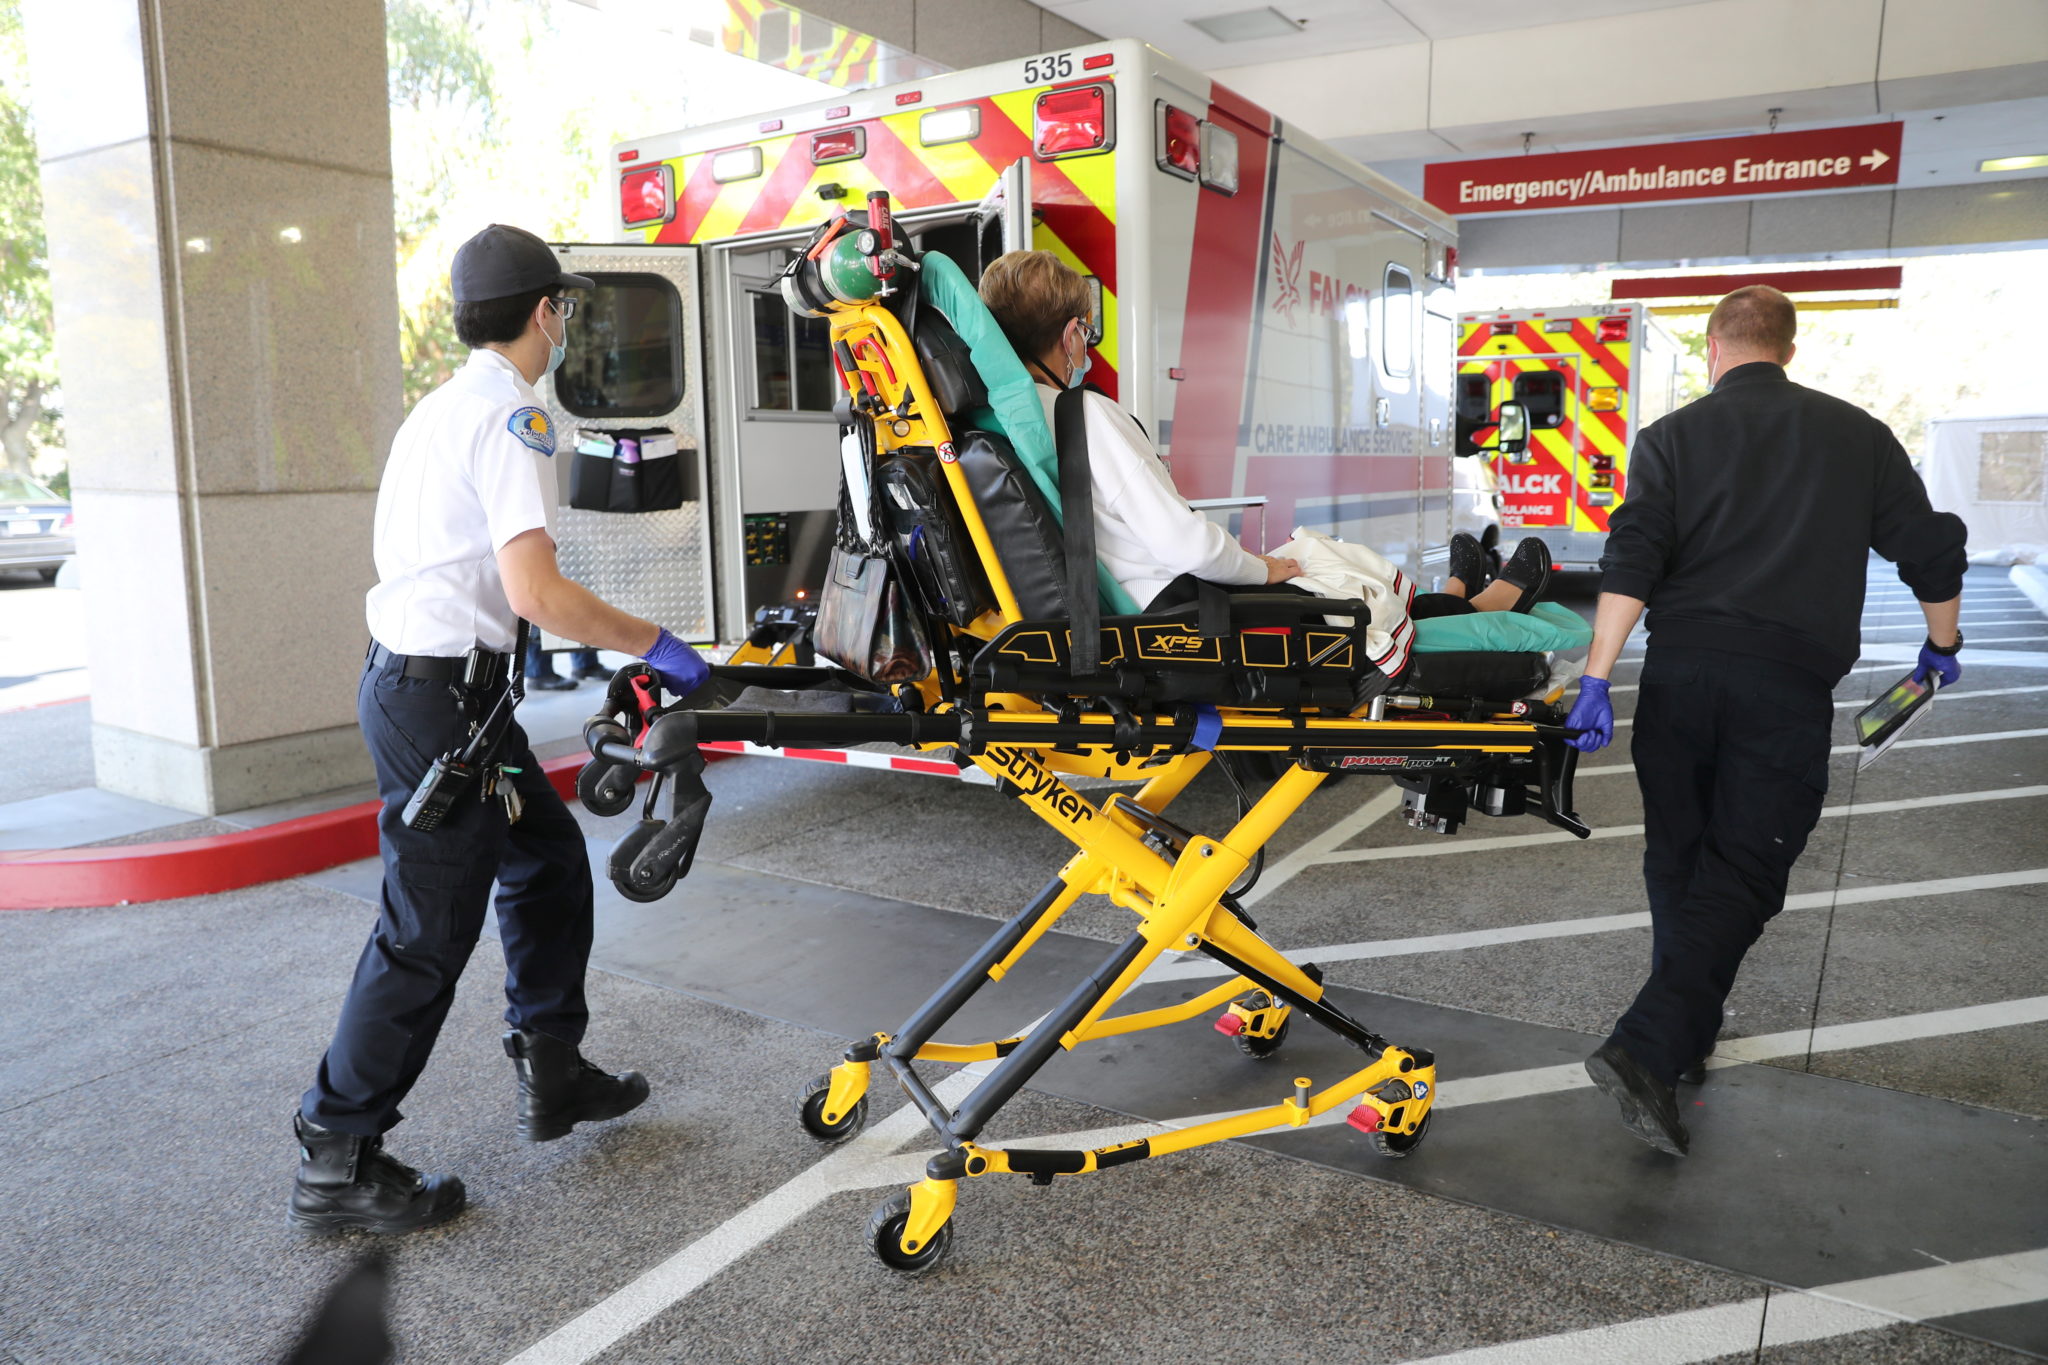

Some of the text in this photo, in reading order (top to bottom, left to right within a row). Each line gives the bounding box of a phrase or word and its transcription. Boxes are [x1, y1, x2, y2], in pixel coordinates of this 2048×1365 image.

[1024, 52, 1073, 84] 535
[1459, 155, 1852, 204] Emergency/Ambulance Entrance
[1592, 304, 1615, 316] 542
[1255, 423, 1413, 454] CARE AMBULANCE SERVICE
[1498, 474, 1562, 494] ALCK
[1150, 635, 1205, 653] XPS
[984, 747, 1093, 824] stryker
